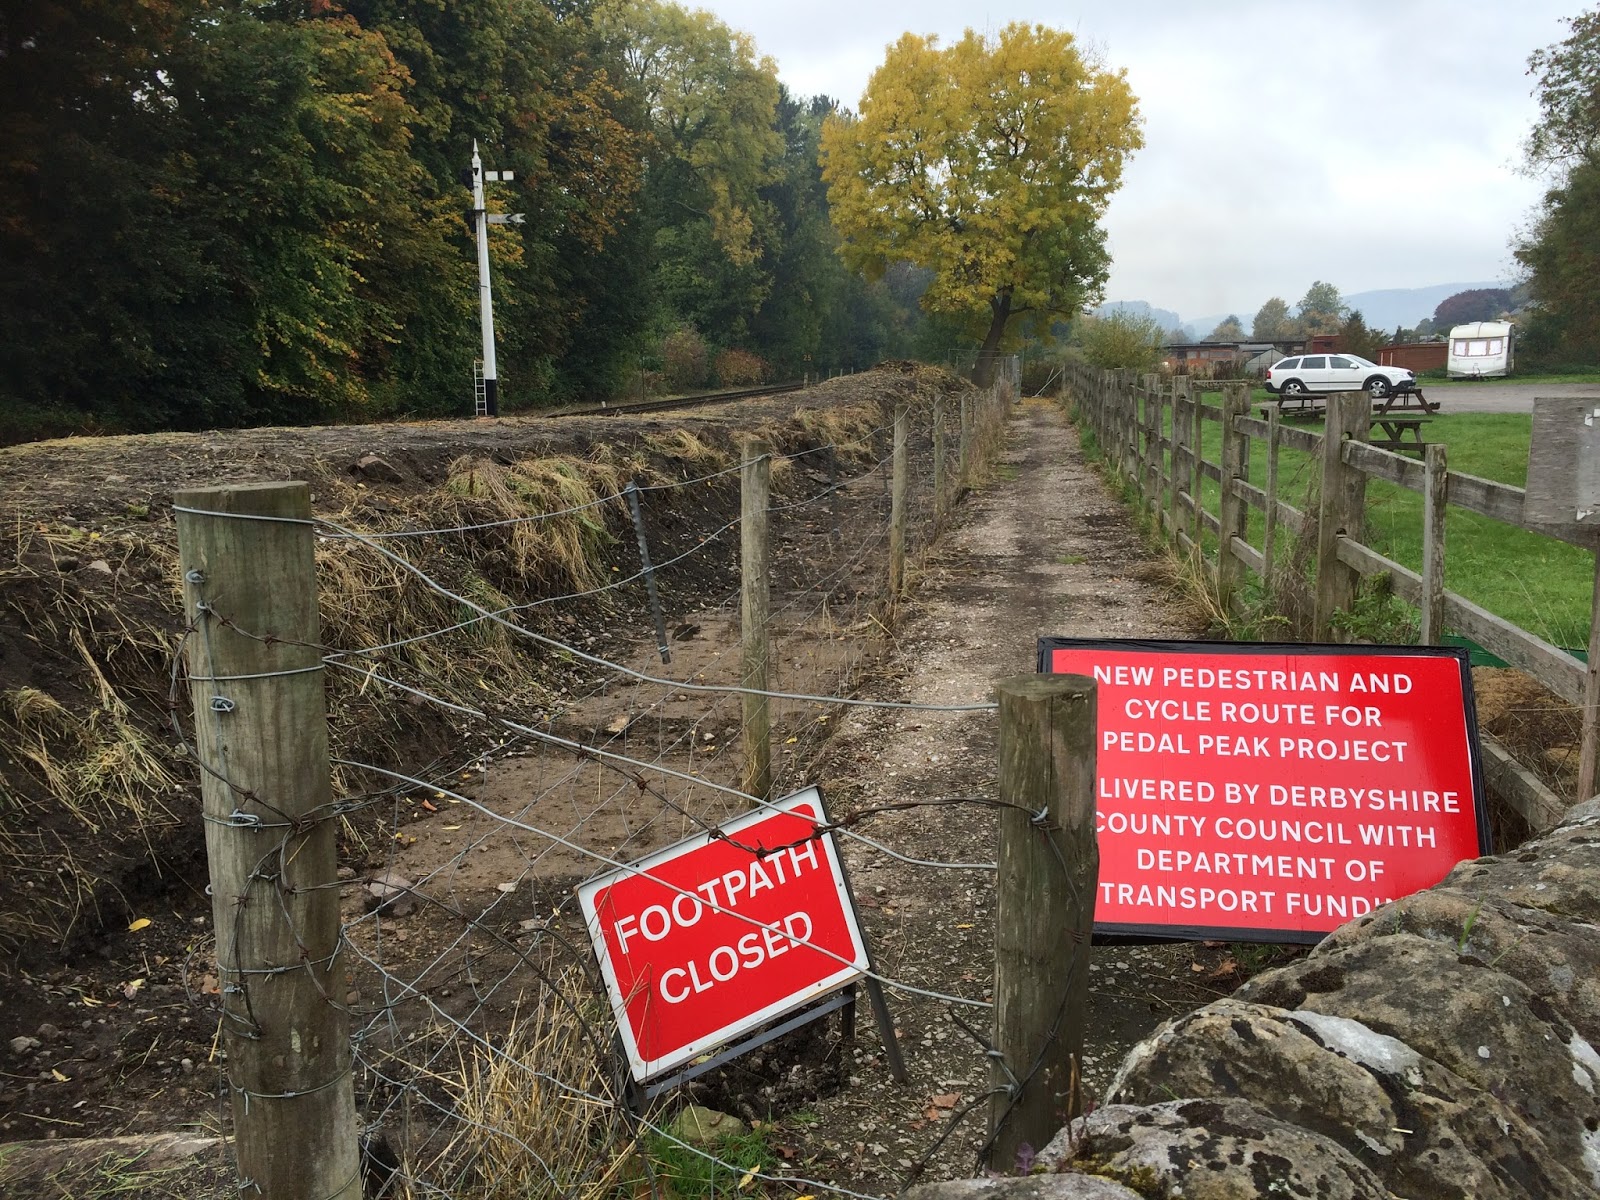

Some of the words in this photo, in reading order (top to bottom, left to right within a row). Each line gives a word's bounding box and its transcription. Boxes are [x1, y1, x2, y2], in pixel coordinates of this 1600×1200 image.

[1093, 665, 1154, 686] NEW
[1163, 667, 1339, 692] PEDESTRIAN
[1349, 673, 1412, 694] AND
[1125, 698, 1212, 722] CYCLE
[1221, 702, 1316, 725] ROUTE
[1325, 705, 1382, 728] FOR
[1103, 731, 1190, 754] PEDAL
[1199, 734, 1271, 757] PEAK
[1279, 737, 1408, 762] PROJECT
[1100, 777, 1215, 802] LIVERED
[1225, 782, 1260, 805] BY
[1269, 784, 1460, 813] DERBYSHIRE
[1215, 817, 1351, 845] COUNCIL
[1358, 824, 1436, 848] WITH
[1137, 848, 1336, 880] DEPARTMENT
[1345, 859, 1384, 882] OF
[613, 840, 819, 955] FOOTPATH
[1100, 882, 1276, 913] TRANSPORT
[1286, 892, 1393, 918] FUND
[659, 911, 813, 1004] CLOSED
